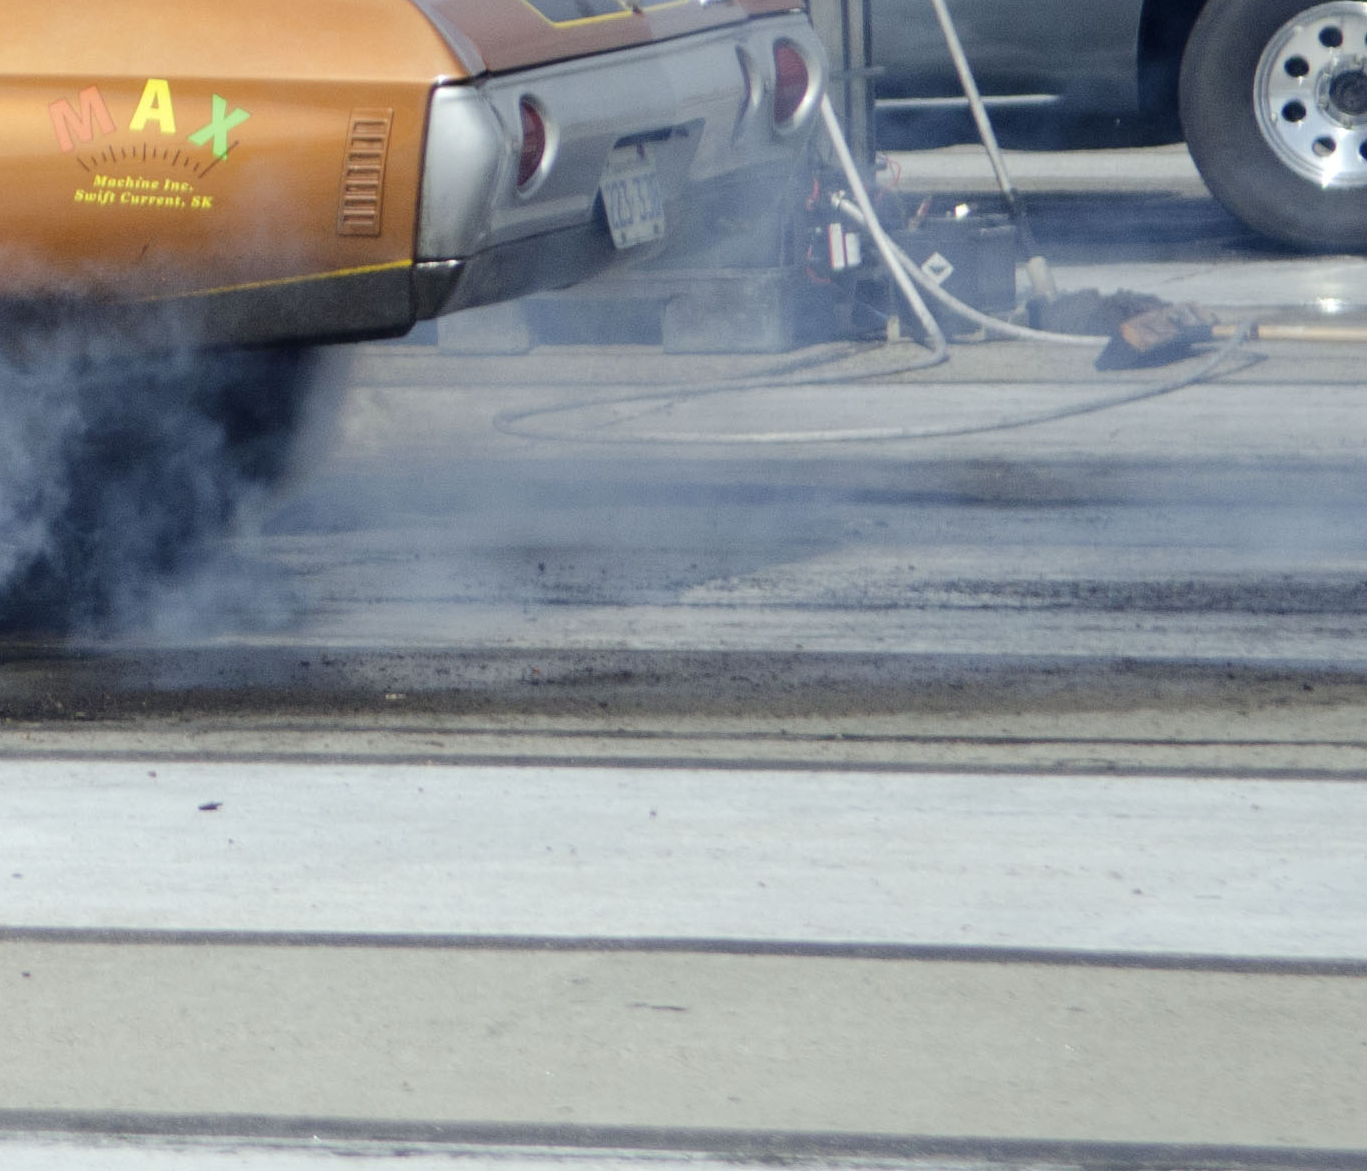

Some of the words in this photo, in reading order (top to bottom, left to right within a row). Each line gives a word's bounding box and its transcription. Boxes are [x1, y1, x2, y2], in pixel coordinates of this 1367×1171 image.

[48, 78, 251, 160] MAX
[93, 174, 160, 189] Machine
[164, 177, 194, 192] Inc.
[74, 189, 116, 205] Swift
[190, 195, 214, 208] SK
